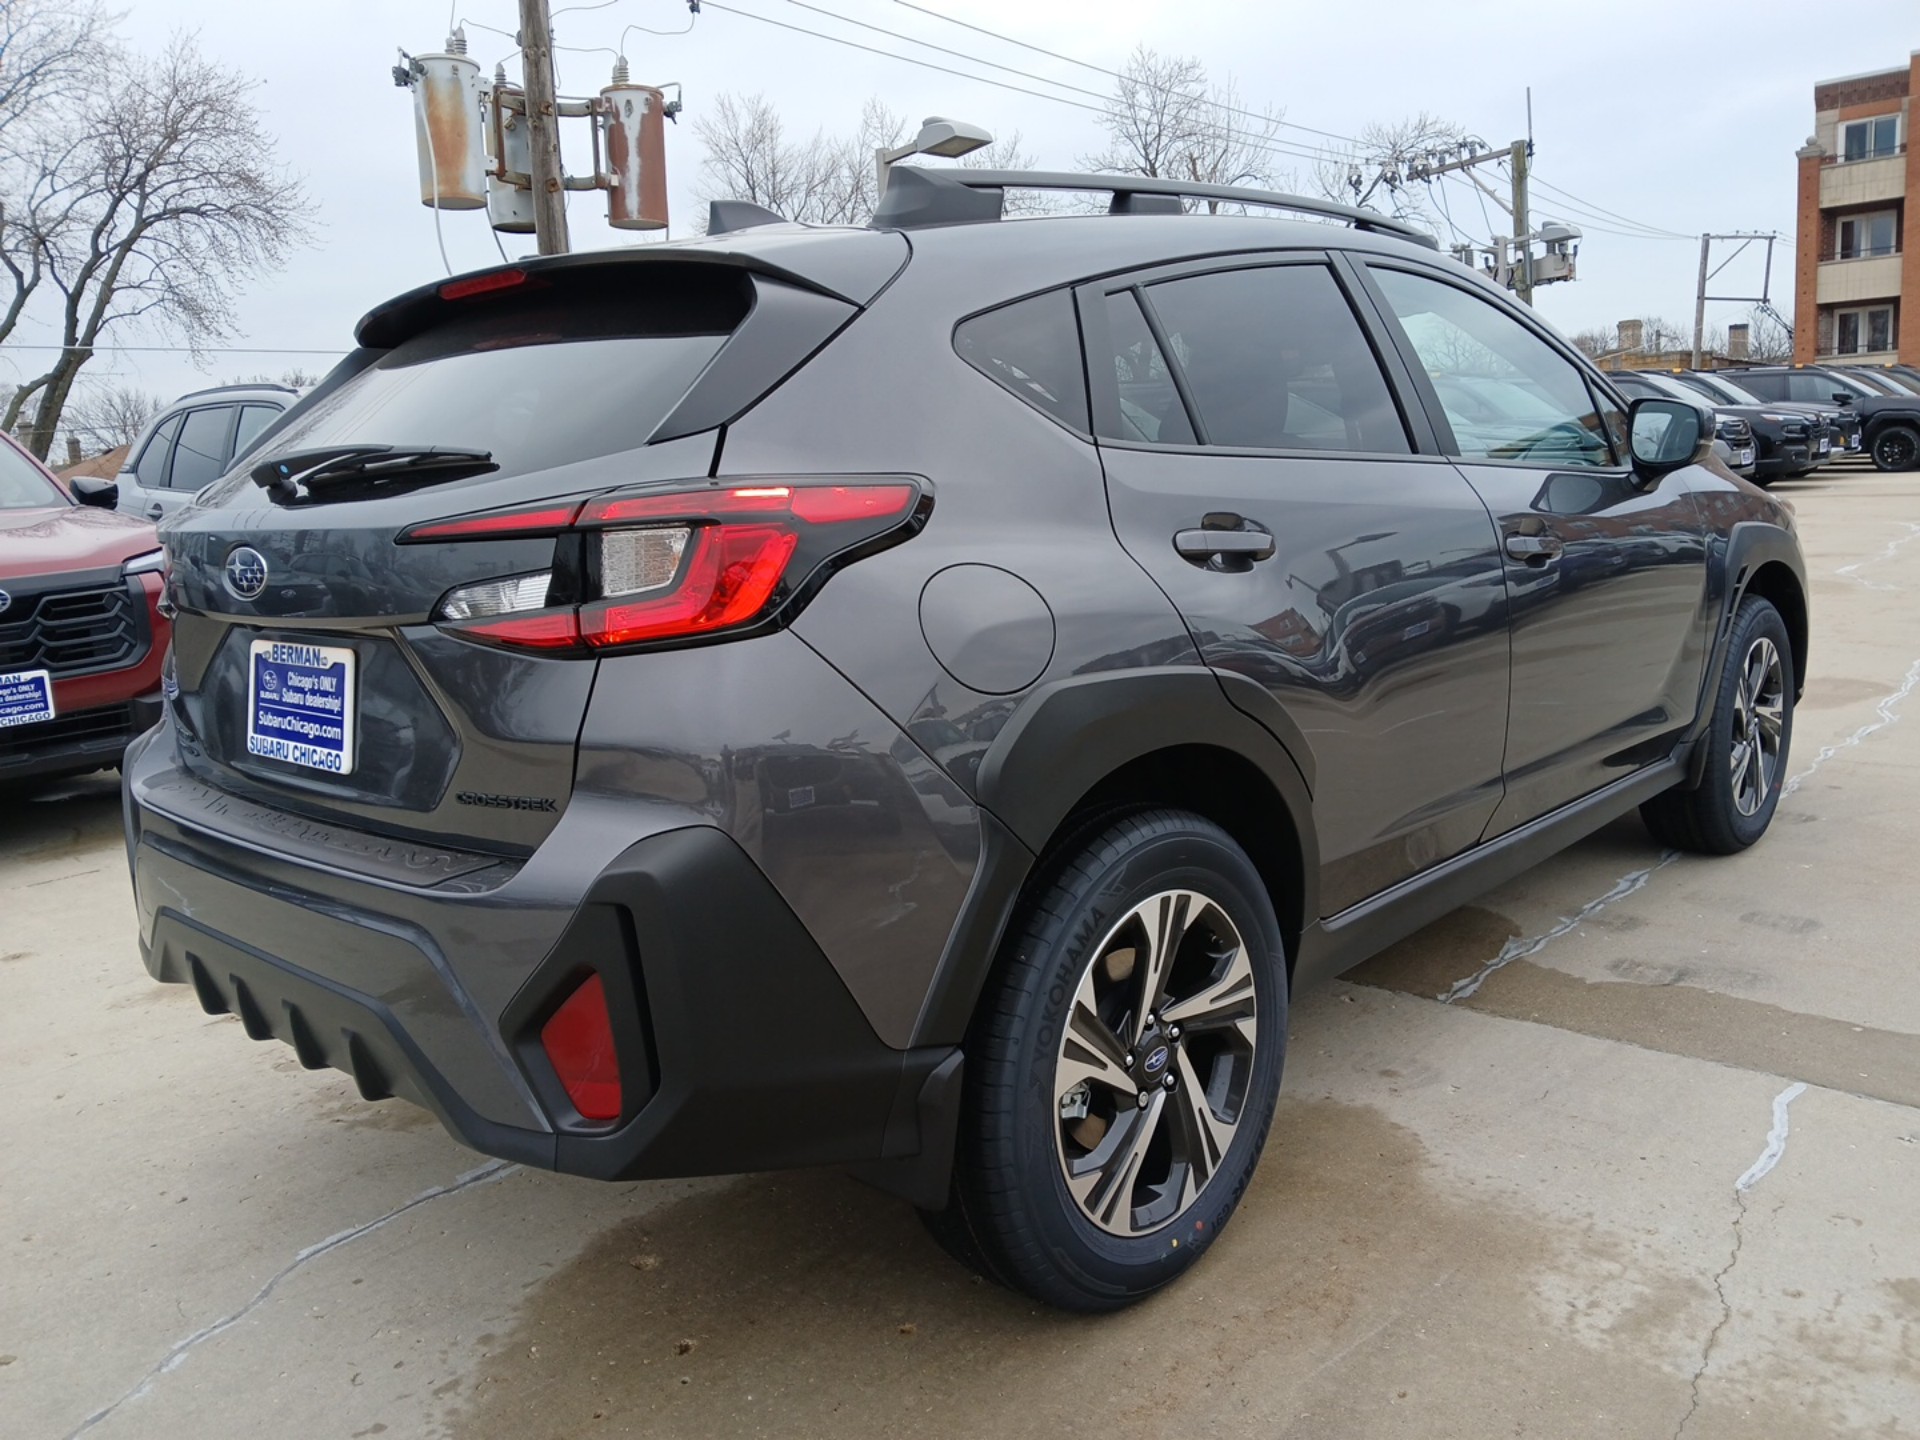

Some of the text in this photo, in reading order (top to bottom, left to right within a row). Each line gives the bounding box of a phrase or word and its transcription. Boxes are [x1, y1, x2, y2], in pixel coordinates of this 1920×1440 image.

[272, 644, 320, 667] BERMAN
[287, 671, 337, 692] Chicago's ONLY
[282, 688, 341, 714] Subaru dealership!
[0, 712, 50, 726] CHICAGO
[258, 711, 341, 739] SubaruChicago.com
[250, 736, 342, 771] SUBARU CHICAGO
[455, 791, 558, 812] CROSSTREK
[1033, 906, 1106, 1067] YOKOHAMA
